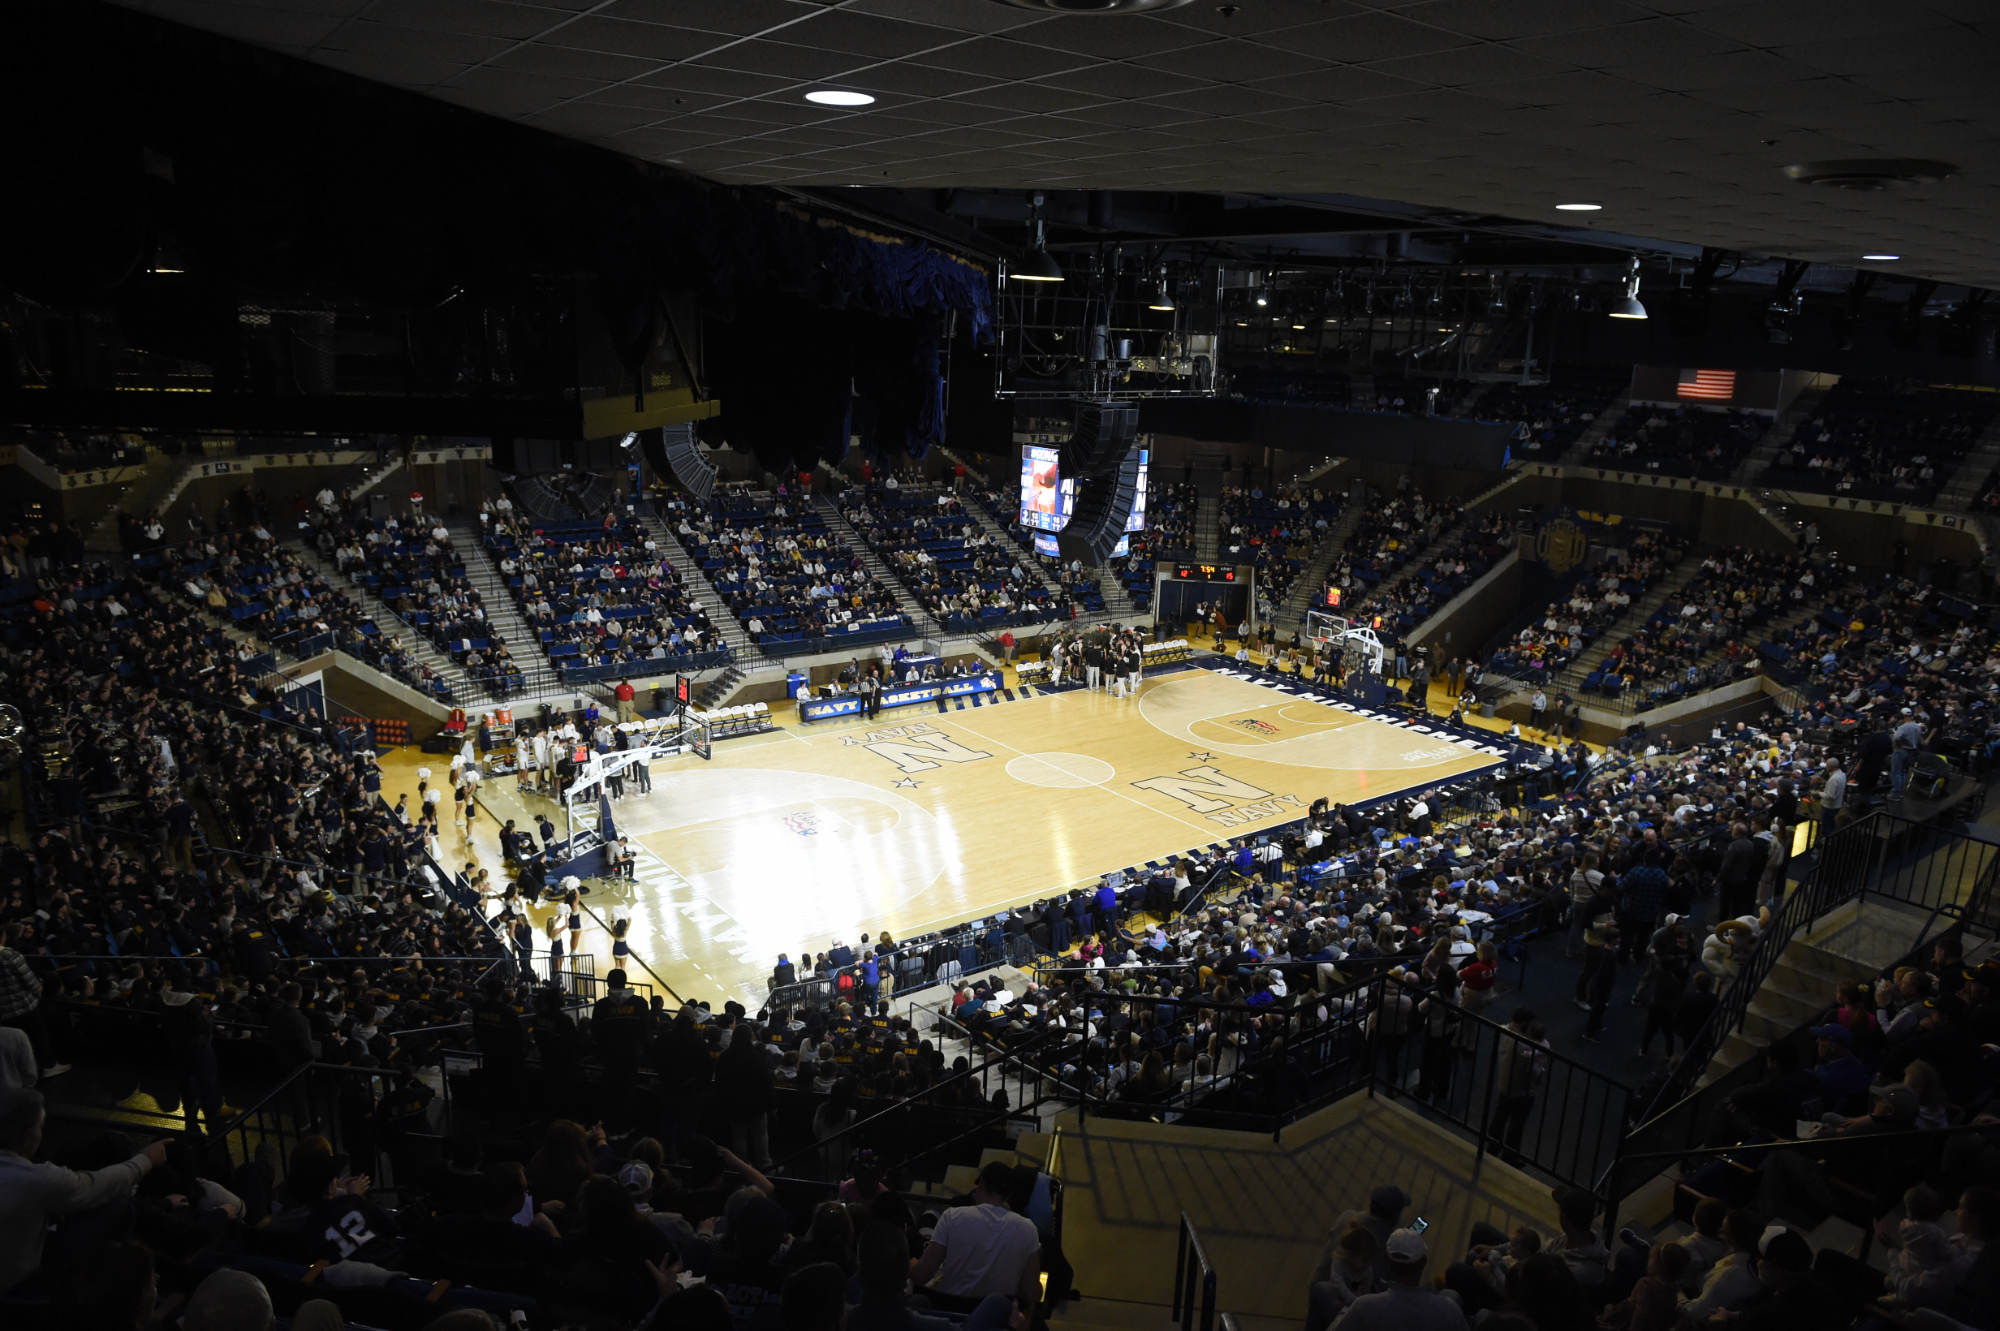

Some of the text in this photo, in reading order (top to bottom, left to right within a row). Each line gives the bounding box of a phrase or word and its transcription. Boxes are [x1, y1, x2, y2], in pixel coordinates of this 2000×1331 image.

[1226, 572, 1233, 580] 15
[807, 701, 858, 717] NAVY
[1296, 692, 1510, 756] MIDSHIPMEN
[838, 721, 939, 747] NAVY
[862, 731, 994, 774] N
[1130, 765, 1274, 814] N
[1205, 794, 1310, 828] NAVY
[324, 1209, 377, 1259] 12
